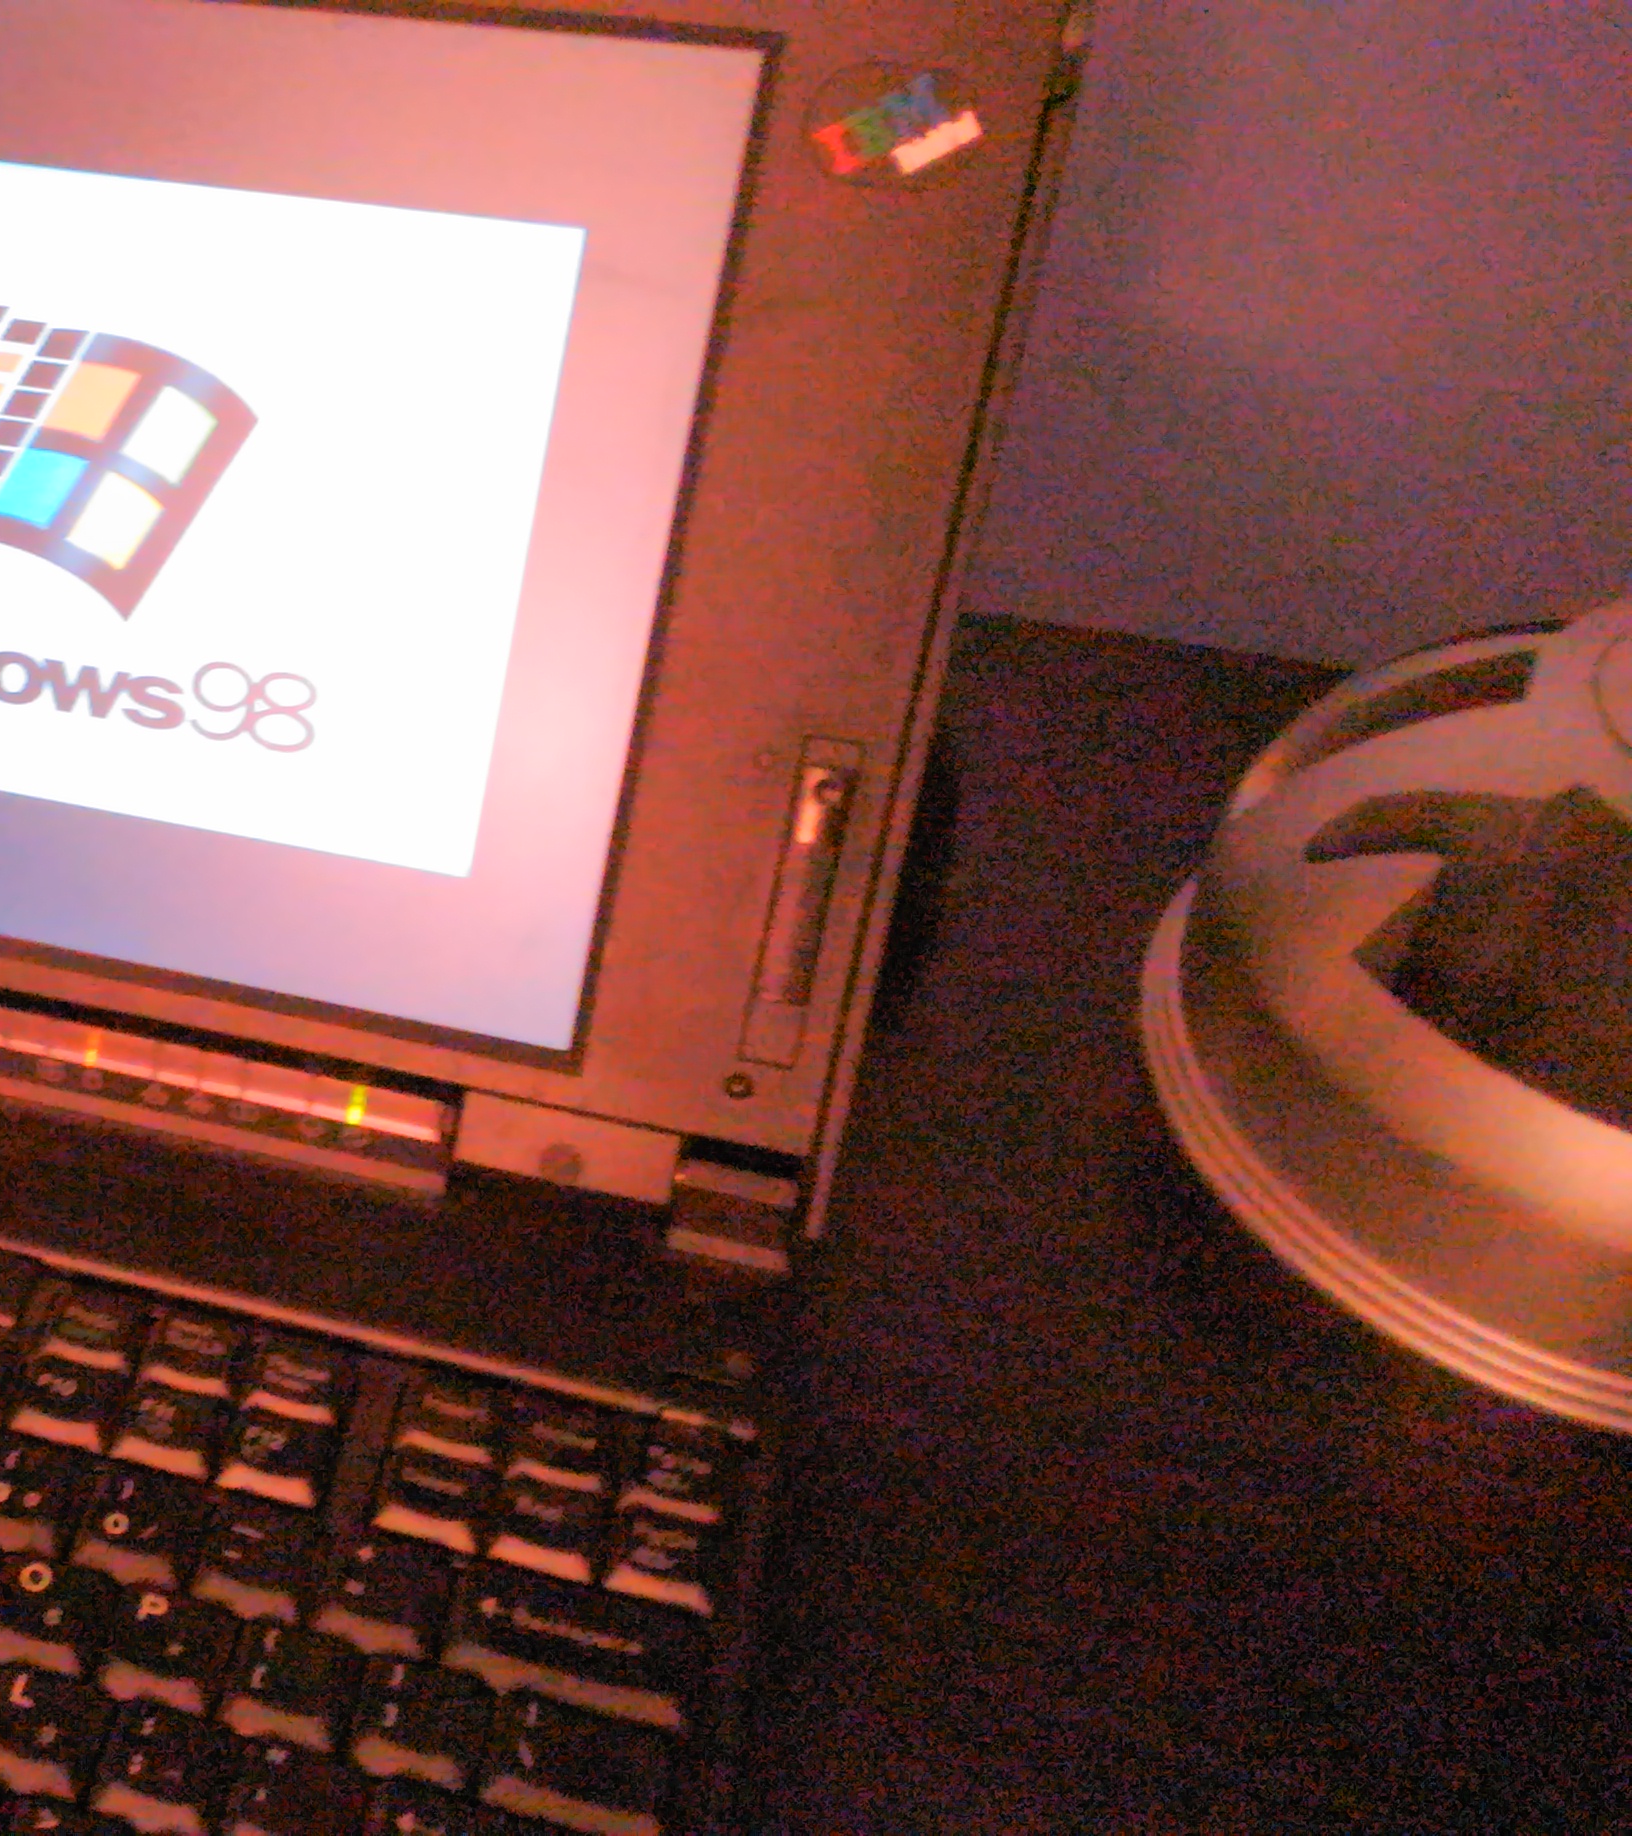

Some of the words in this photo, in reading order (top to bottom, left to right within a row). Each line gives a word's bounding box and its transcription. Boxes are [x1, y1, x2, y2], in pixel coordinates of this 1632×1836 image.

[17, 1561, 54, 1594] O
[135, 1591, 171, 1622] P
[8, 1673, 34, 1709] L
